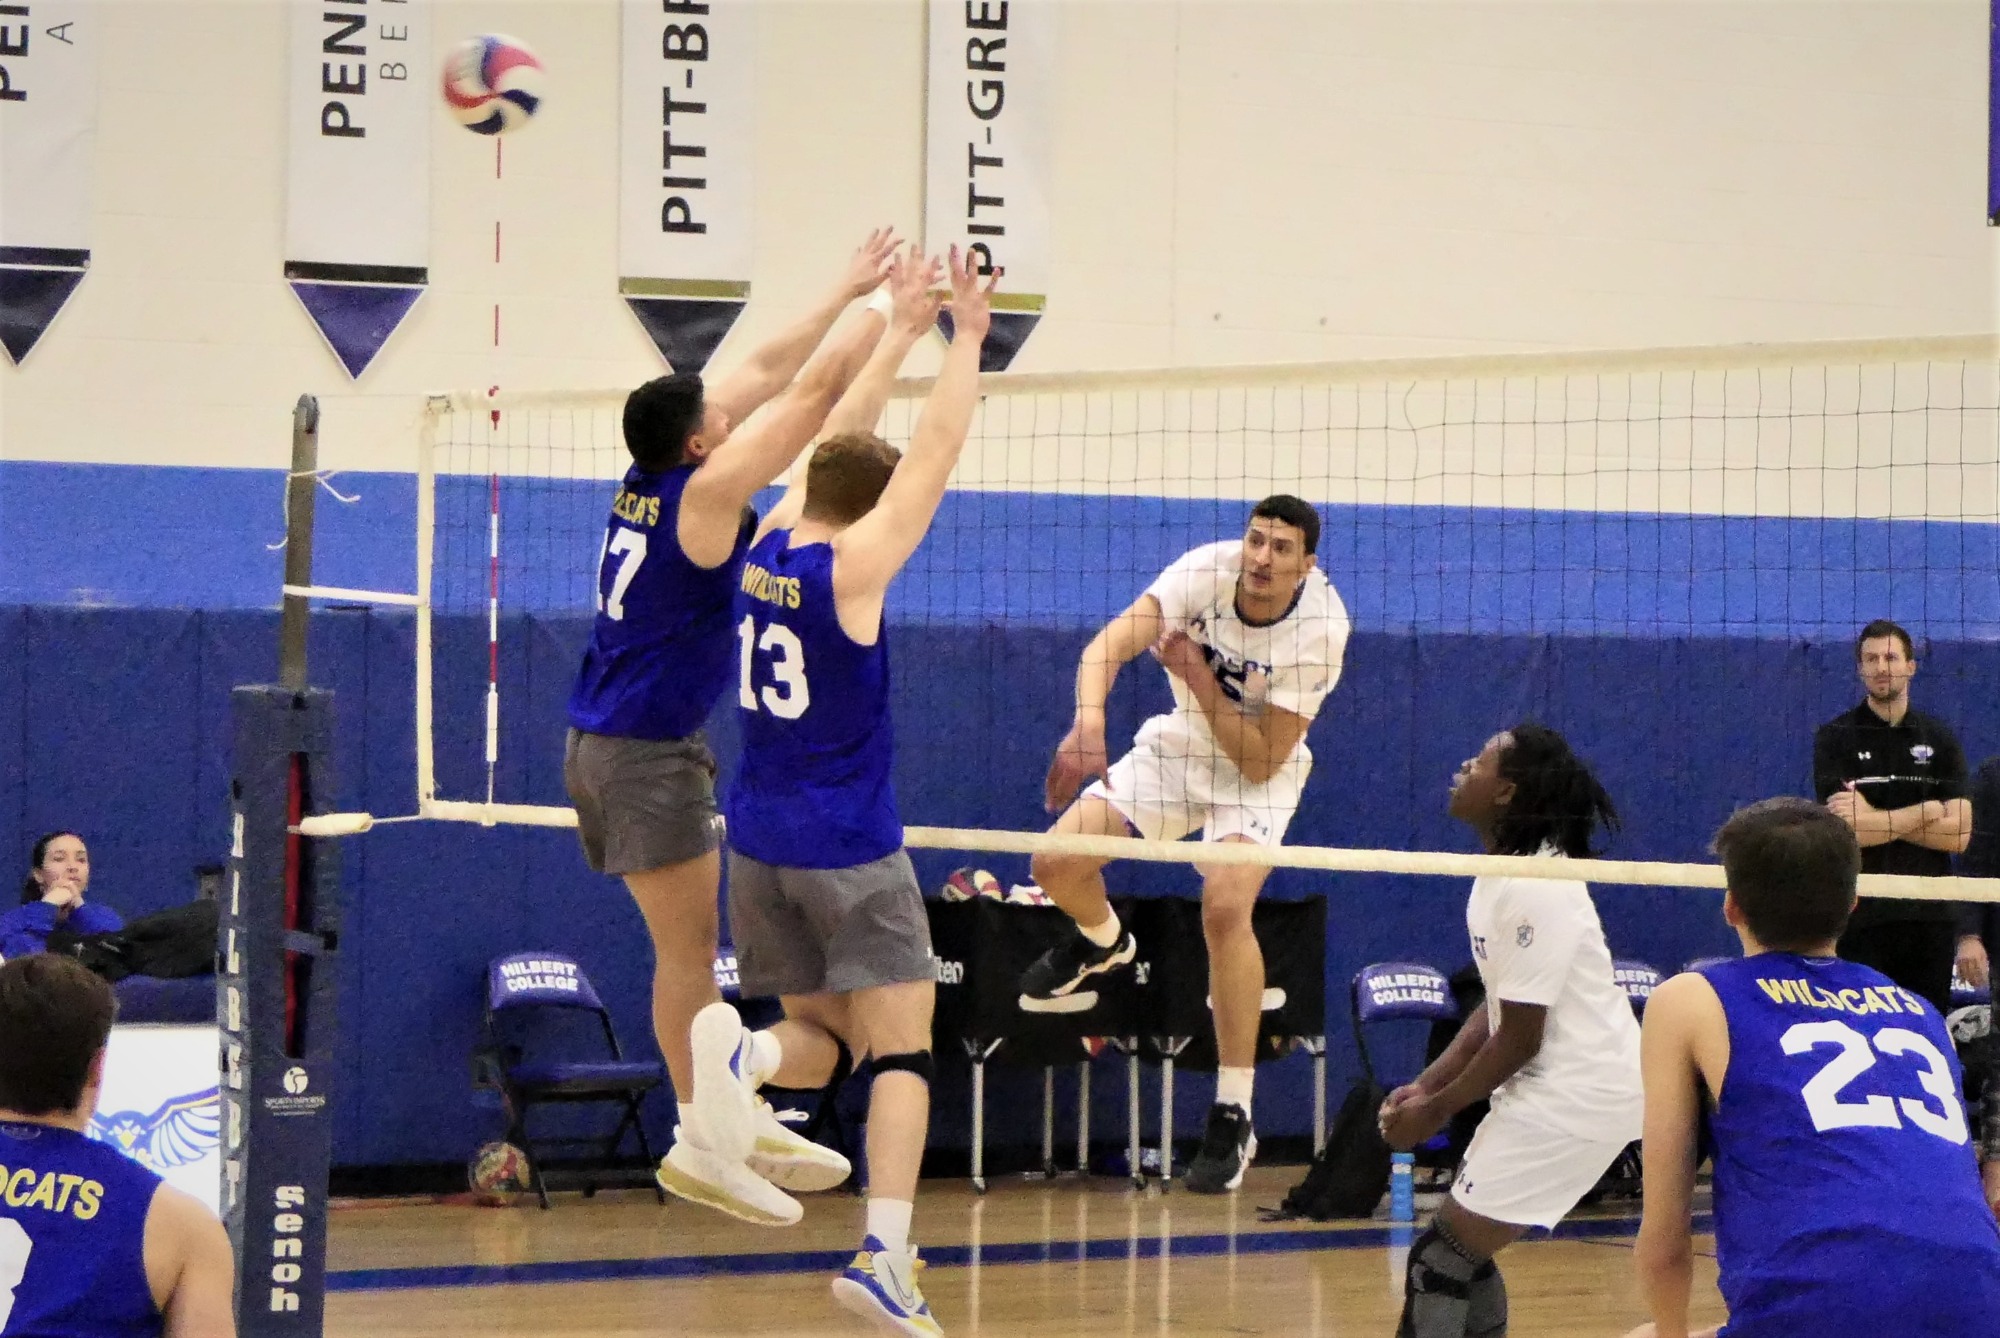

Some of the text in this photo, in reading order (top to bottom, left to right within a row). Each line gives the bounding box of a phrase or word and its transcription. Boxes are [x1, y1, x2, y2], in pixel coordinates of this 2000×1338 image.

[0, 0, 29, 101] PE
[321, 0, 367, 138] PEN
[379, 0, 408, 81] BE
[738, 614, 810, 720] 13
[501, 960, 577, 977] HILBERT
[507, 975, 578, 992] COLLEGE
[1368, 974, 1443, 990] HILBERT
[1373, 988, 1444, 1005] COLLEGE
[1756, 978, 1924, 1016] WILDCATS
[1779, 1019, 1968, 1146] 23
